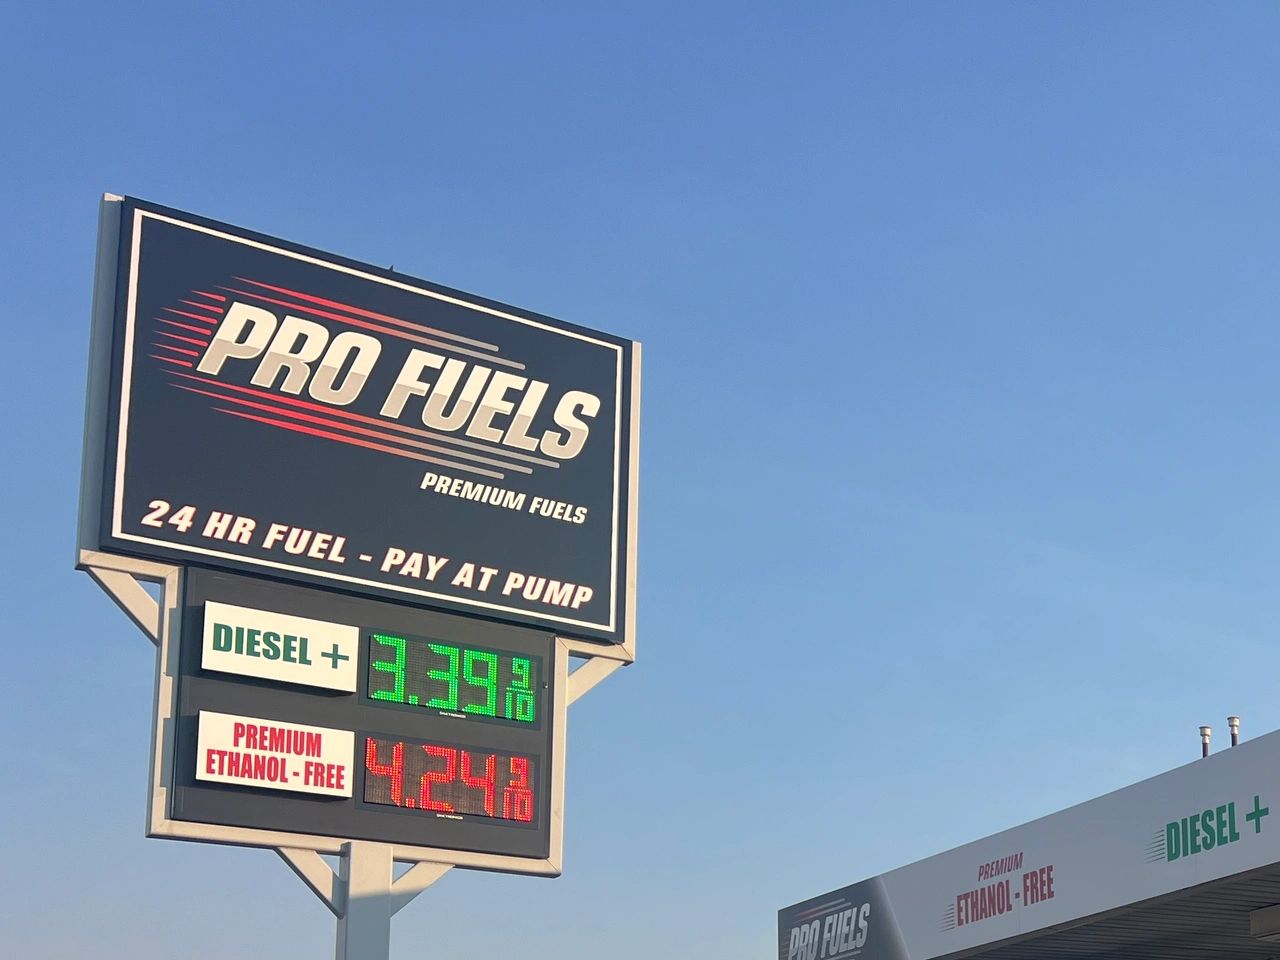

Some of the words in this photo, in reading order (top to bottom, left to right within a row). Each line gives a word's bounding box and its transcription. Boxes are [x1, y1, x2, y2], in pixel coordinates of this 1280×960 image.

[196, 301, 382, 406] PRO
[380, 348, 601, 459] FUELS
[420, 471, 526, 512] PREMIUM
[529, 495, 588, 525] FUELS
[141, 500, 195, 535] 24
[202, 511, 256, 546] HR
[262, 523, 346, 564] FUEL
[381, 546, 450, 582] PAY
[451, 561, 499, 593] AT
[505, 571, 596, 611] PUMP
[212, 622, 312, 666] DIESEL
[370, 634, 498, 717] 3.39
[233, 722, 322, 759] PREMIUM
[366, 737, 496, 817] 4.24
[1166, 801, 1240, 862] DIESEL
[977, 852, 1023, 882] PREMIUM
[821, 903, 871, 959] FUELS
